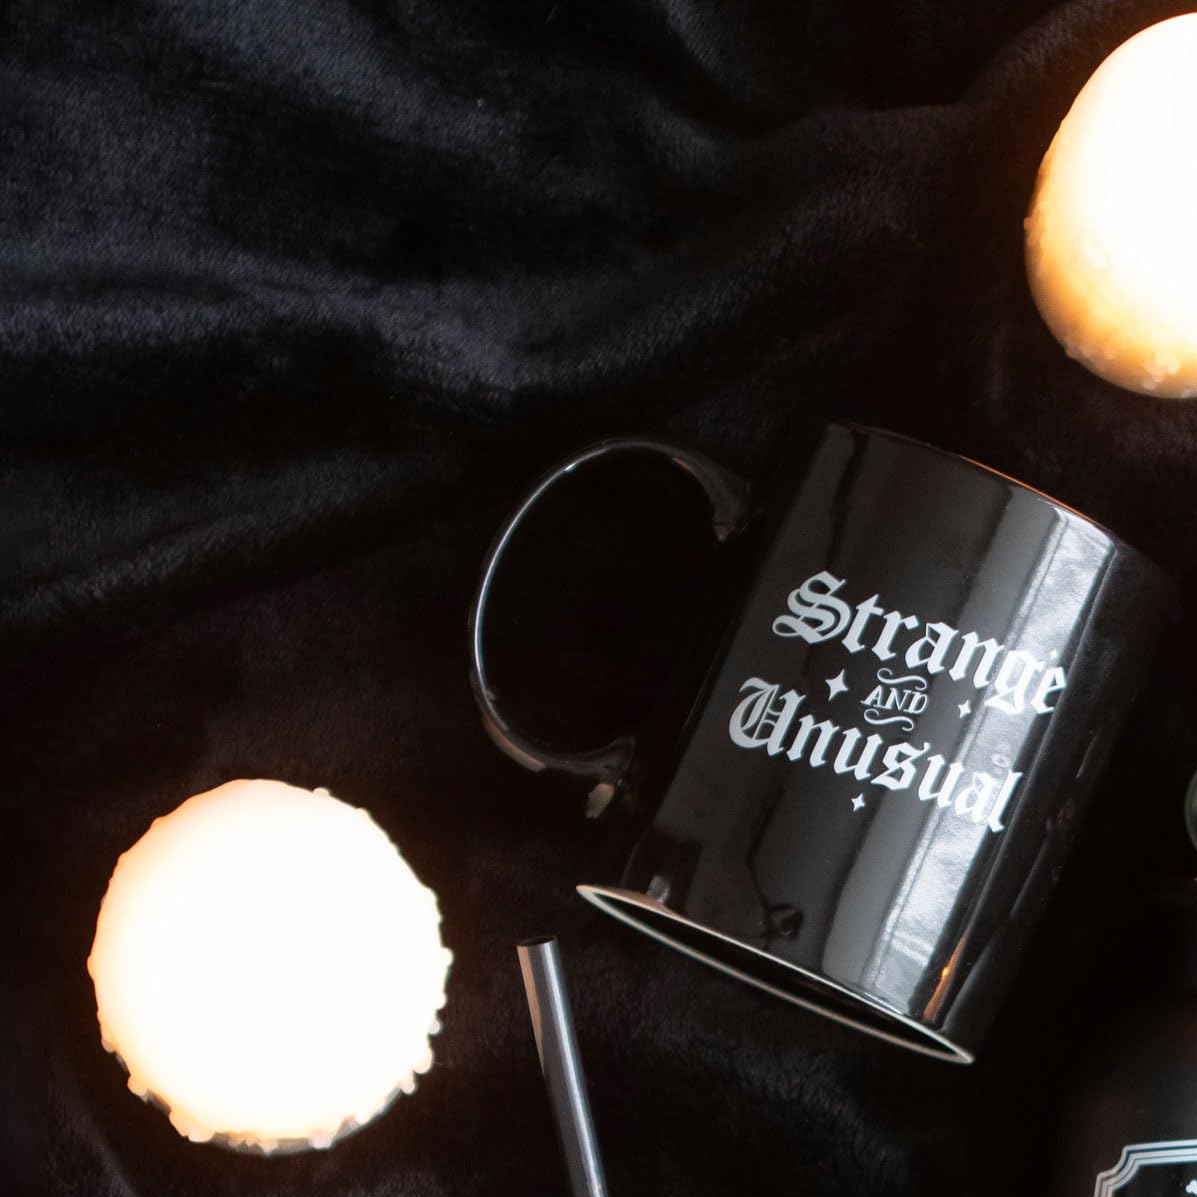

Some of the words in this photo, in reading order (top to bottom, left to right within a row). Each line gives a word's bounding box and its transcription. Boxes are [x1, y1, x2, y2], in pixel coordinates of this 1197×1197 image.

[772, 571, 1067, 716] Strange
[861, 685, 928, 715] AND
[729, 677, 1024, 832] Unusual
